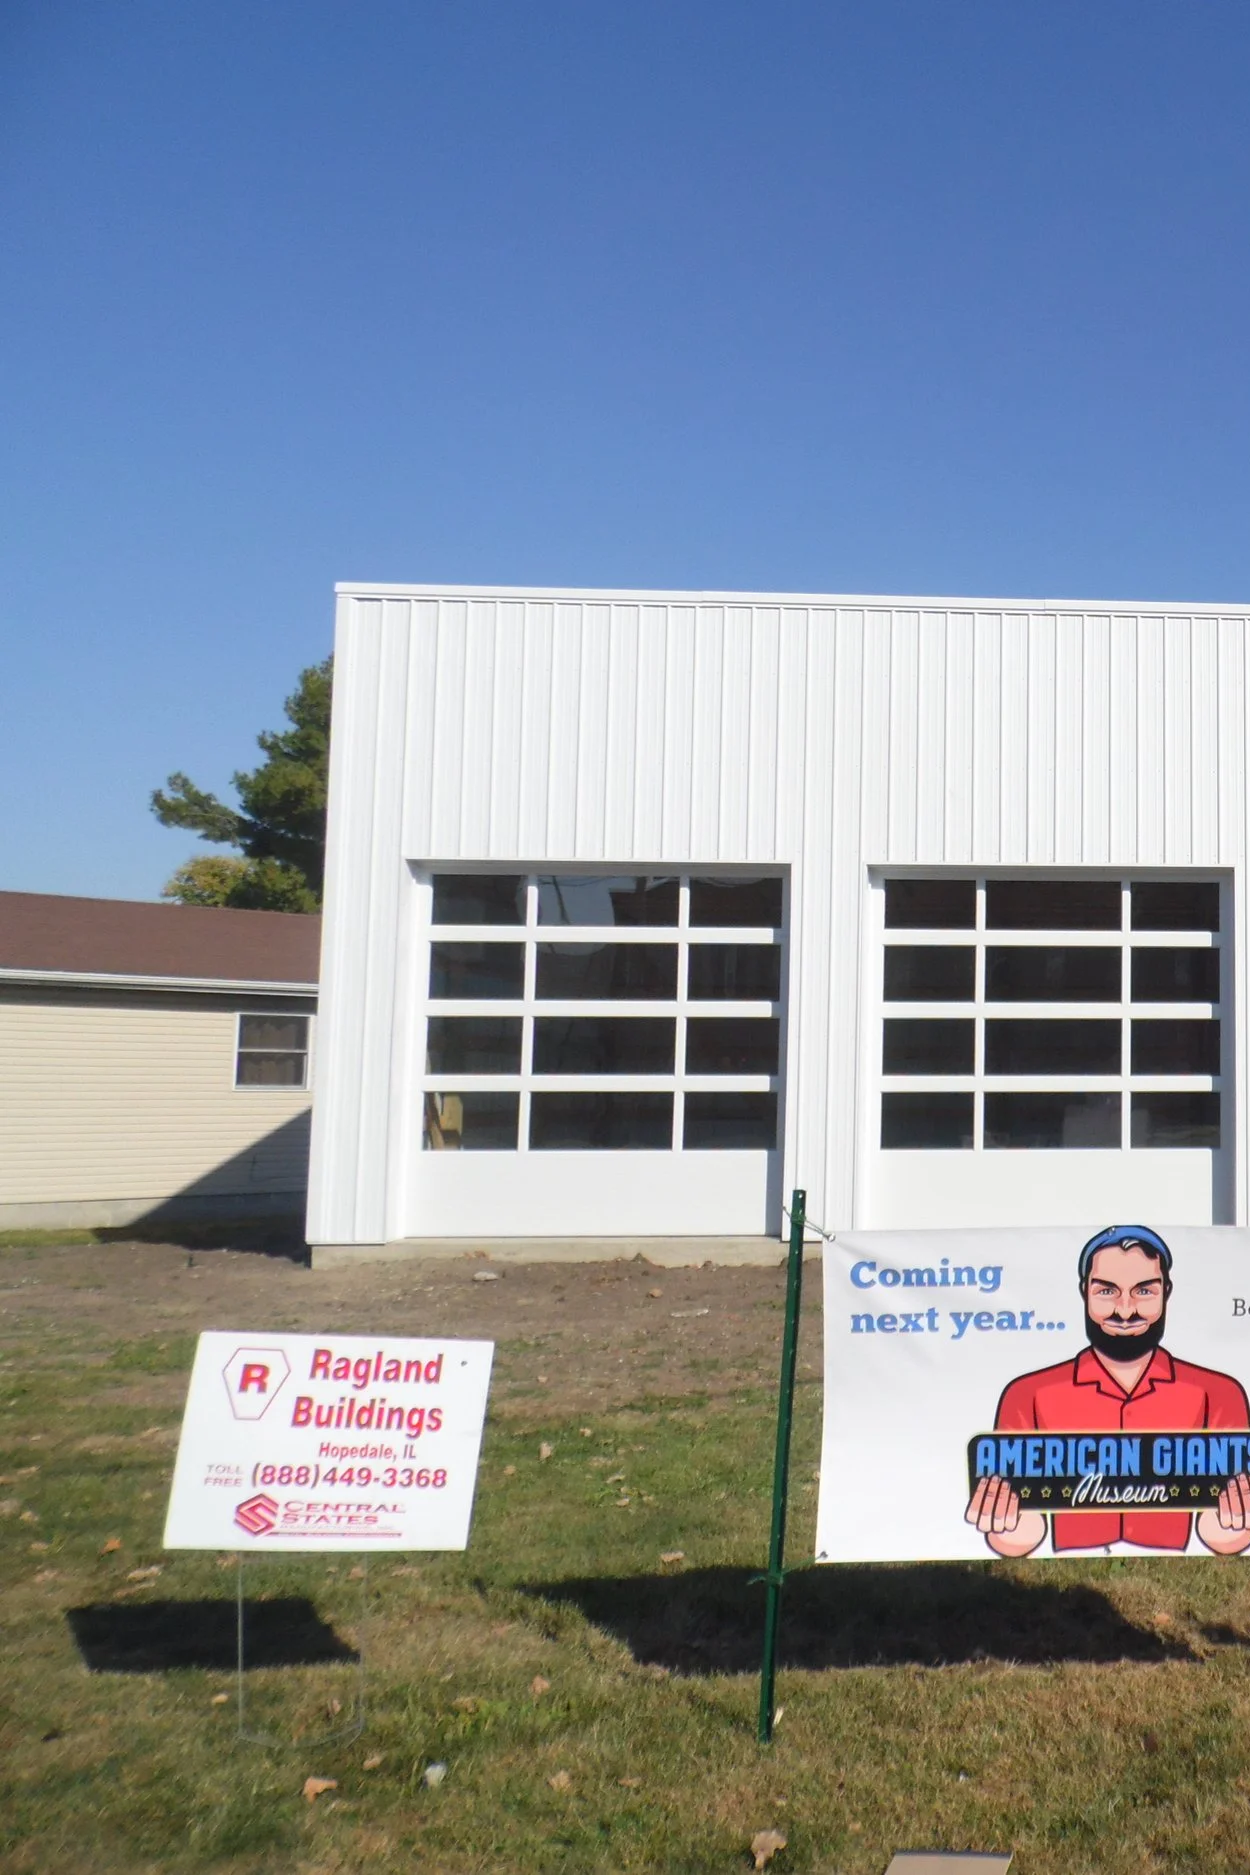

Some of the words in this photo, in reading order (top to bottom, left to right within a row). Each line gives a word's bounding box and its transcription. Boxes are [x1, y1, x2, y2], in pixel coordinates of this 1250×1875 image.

[850, 1257, 1003, 1293] Coming
[850, 1307, 939, 1334] next
[949, 1309, 1066, 1341] year...
[238, 1363, 270, 1393] R
[309, 1348, 444, 1390] Ragland
[290, 1396, 444, 1440] Buildings
[318, 1442, 397, 1461] Hopedale,
[402, 1444, 417, 1459] IL
[975, 1436, 1142, 1478] AMERICAN
[203, 1476, 243, 1488] FREE
[206, 1464, 244, 1475] TOLL
[251, 1462, 448, 1490] (888)449-3368
[1071, 1471, 1169, 1507] Museum
